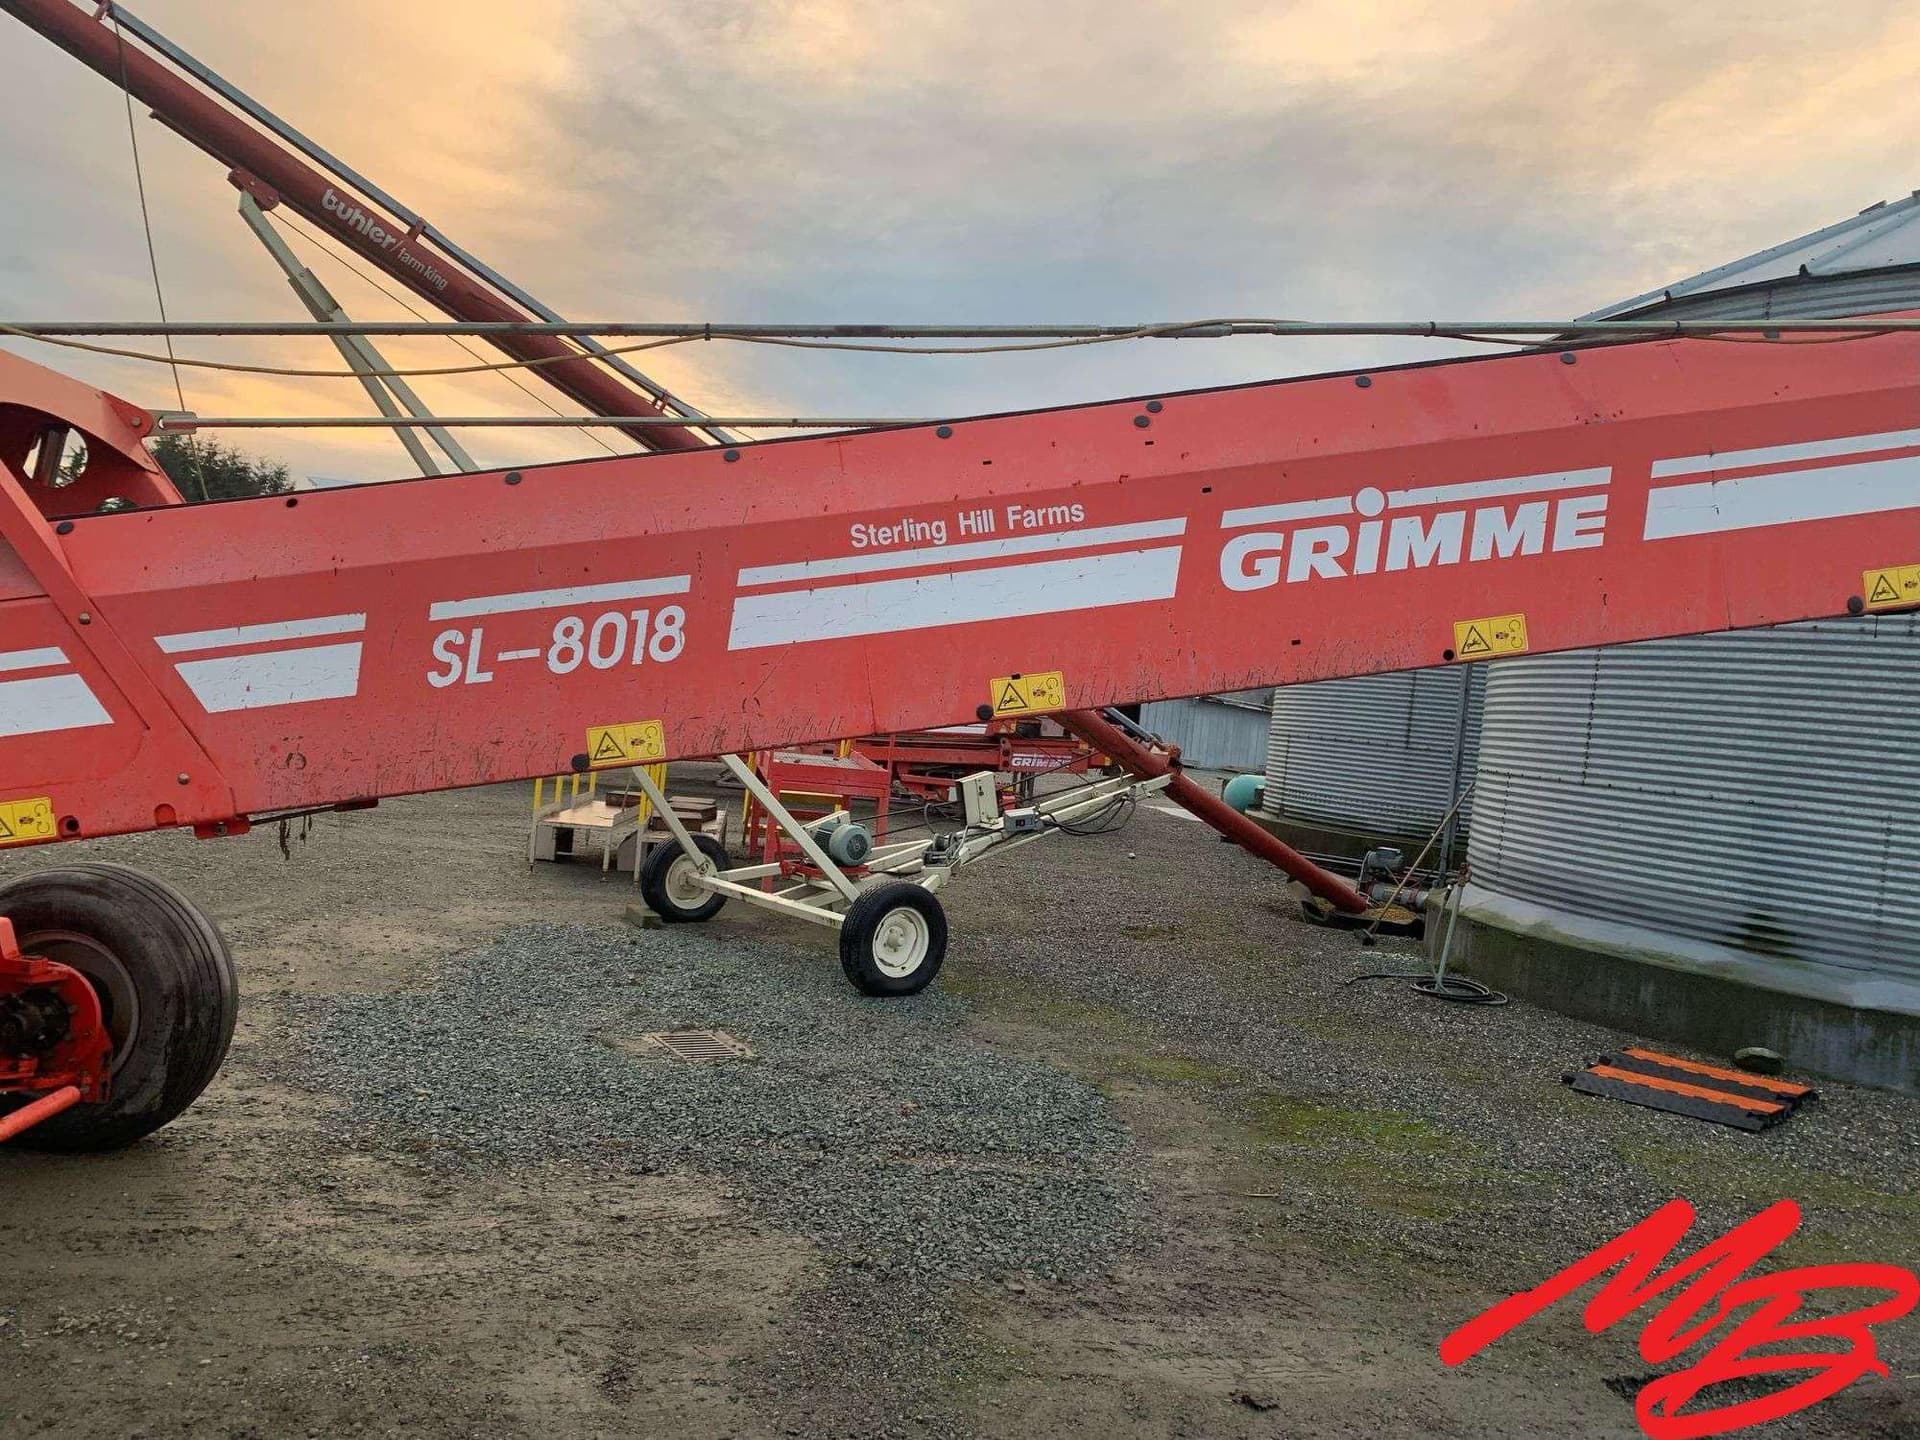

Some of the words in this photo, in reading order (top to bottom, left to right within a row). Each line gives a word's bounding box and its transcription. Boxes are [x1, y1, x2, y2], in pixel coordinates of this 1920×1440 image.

[421, 265, 449, 292] king
[850, 519, 948, 548] Sterling
[958, 508, 996, 536] Hill
[1006, 503, 1086, 530] Farms
